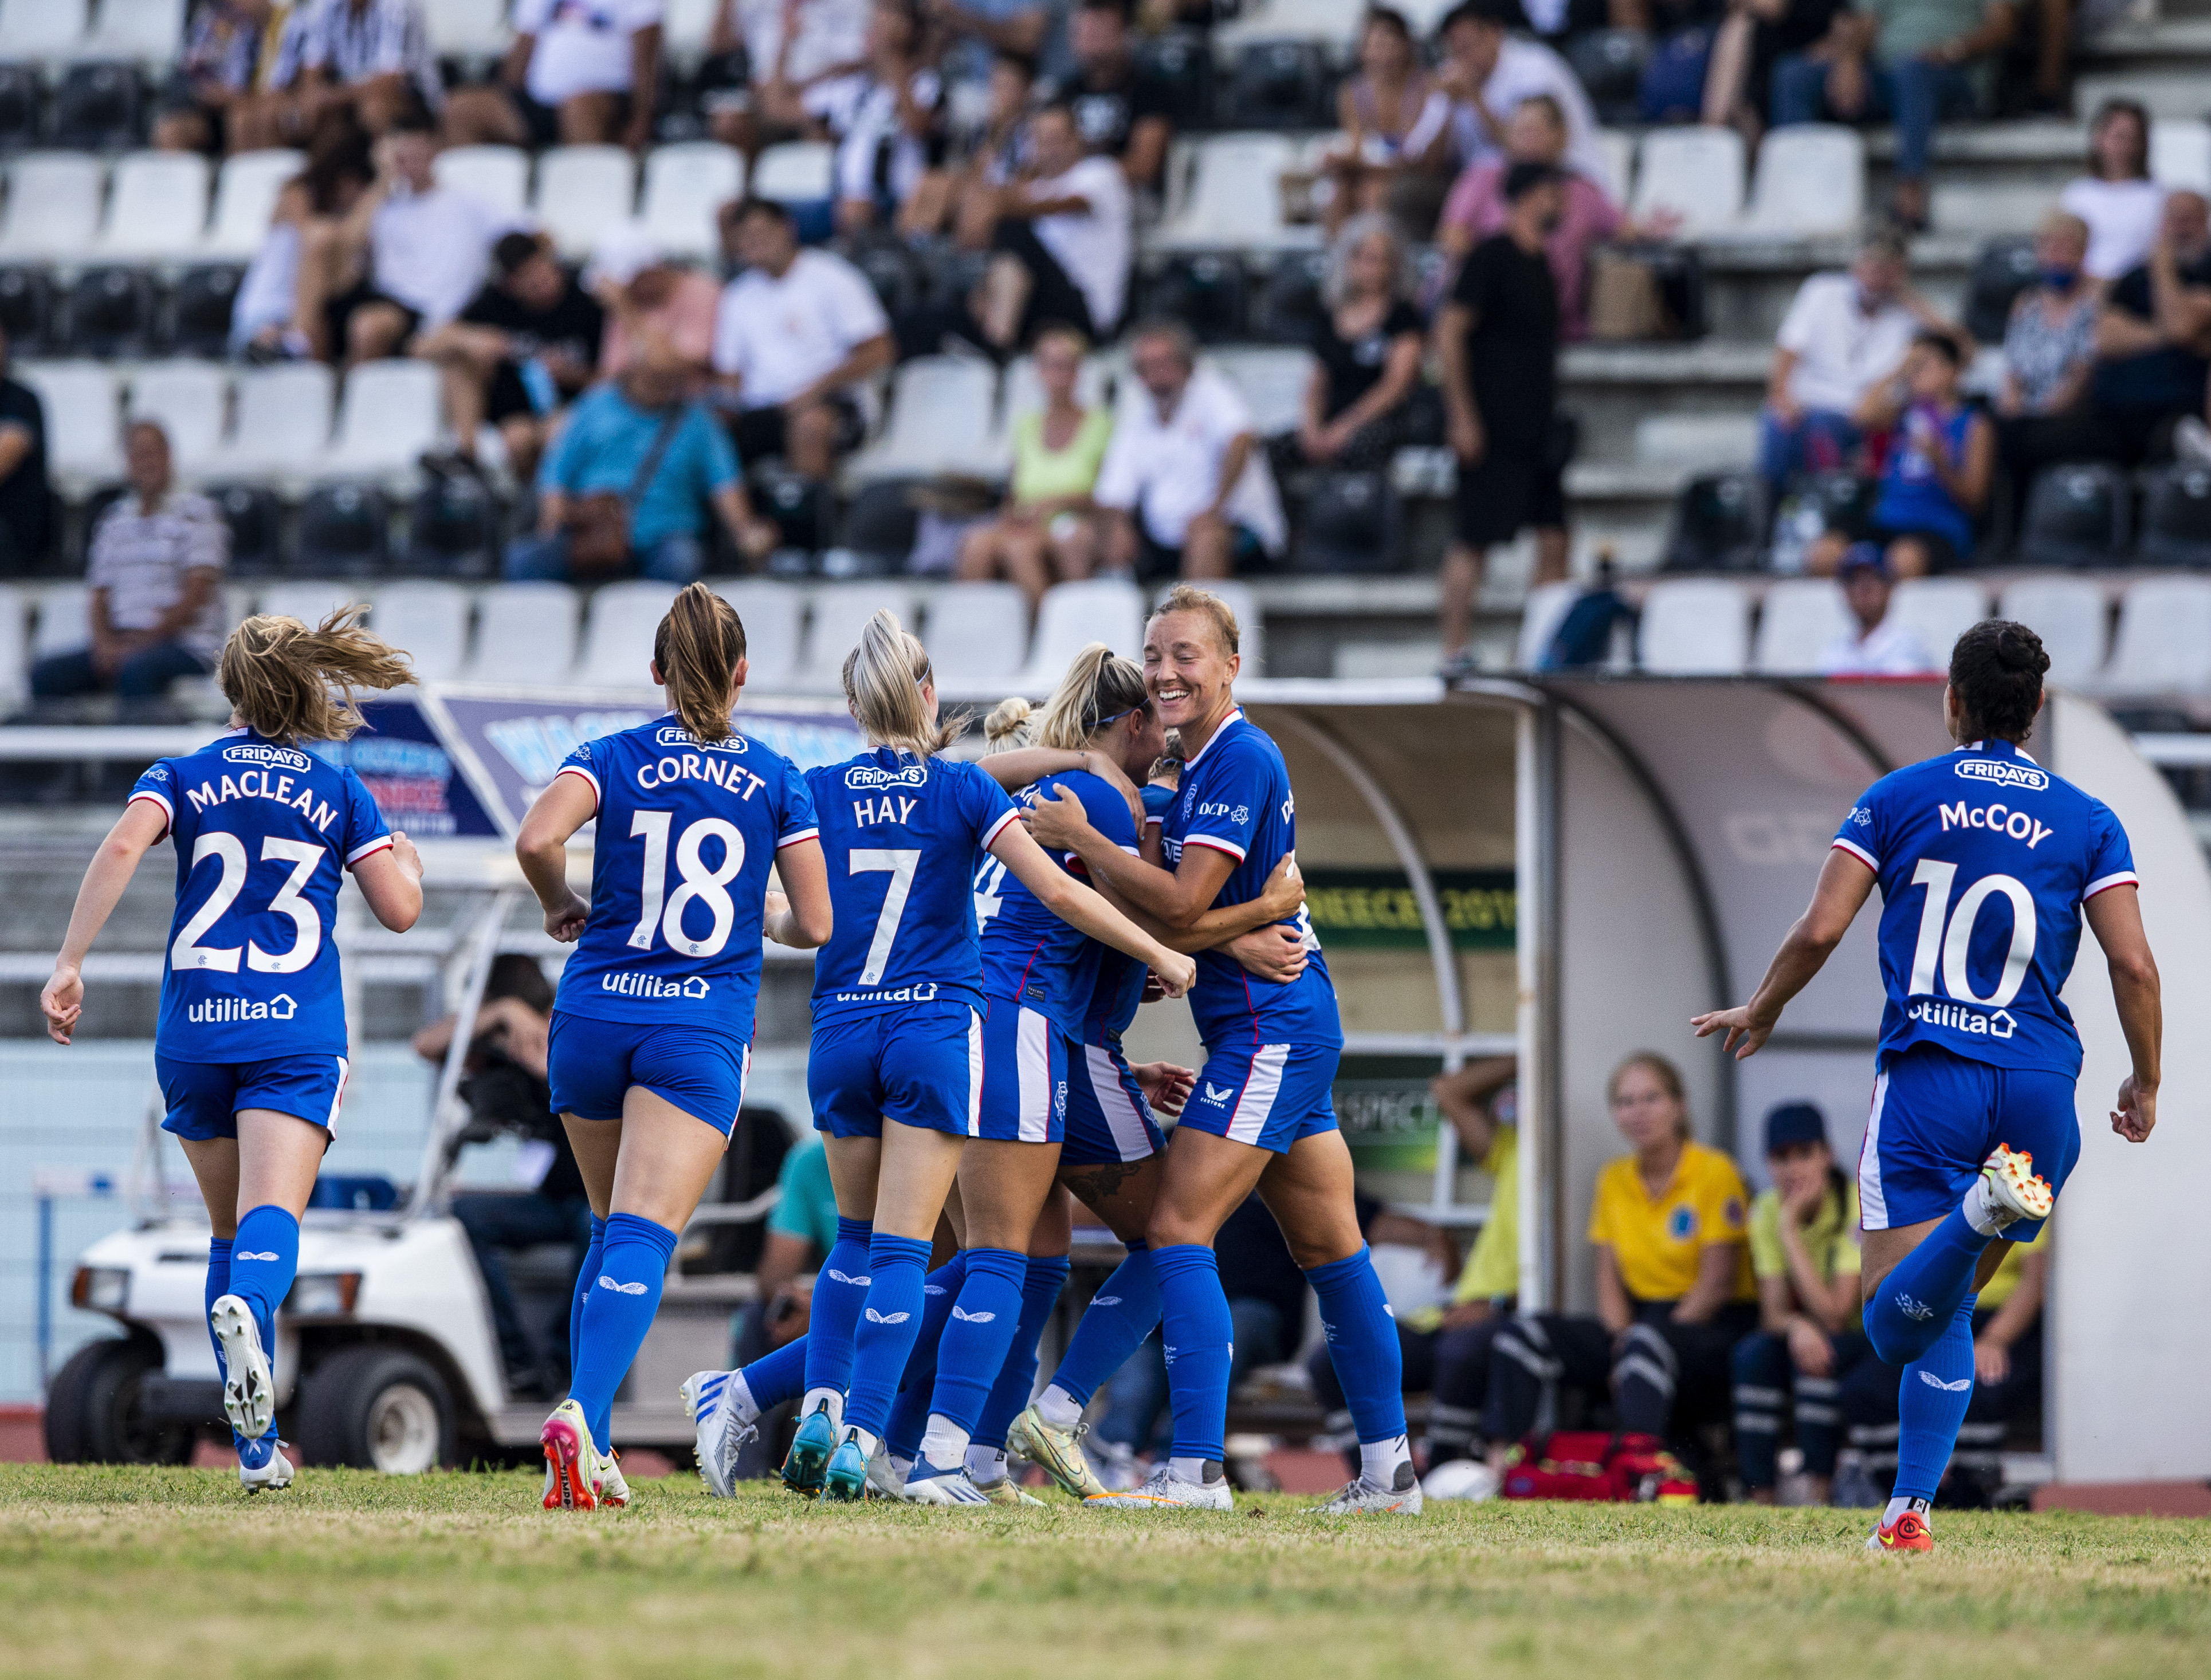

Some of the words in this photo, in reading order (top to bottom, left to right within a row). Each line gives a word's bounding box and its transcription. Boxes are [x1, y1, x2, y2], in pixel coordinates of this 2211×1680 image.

[230, 747, 305, 768] FRIDAYS
[637, 753, 767, 802] CORNET
[852, 769, 920, 785] FRIDAYS
[1963, 763, 2041, 786] FRIDAYS
[185, 770, 339, 833] MACLEAN
[853, 796, 918, 828] HAY
[1198, 802, 1230, 817] DCP
[1939, 800, 2054, 849] McCOY
[171, 831, 328, 974] 23
[627, 809, 746, 958] 18
[849, 849, 922, 986] 7
[1907, 858, 2037, 1008] 10
[602, 972, 680, 998] utilita
[188, 998, 268, 1022] utilita
